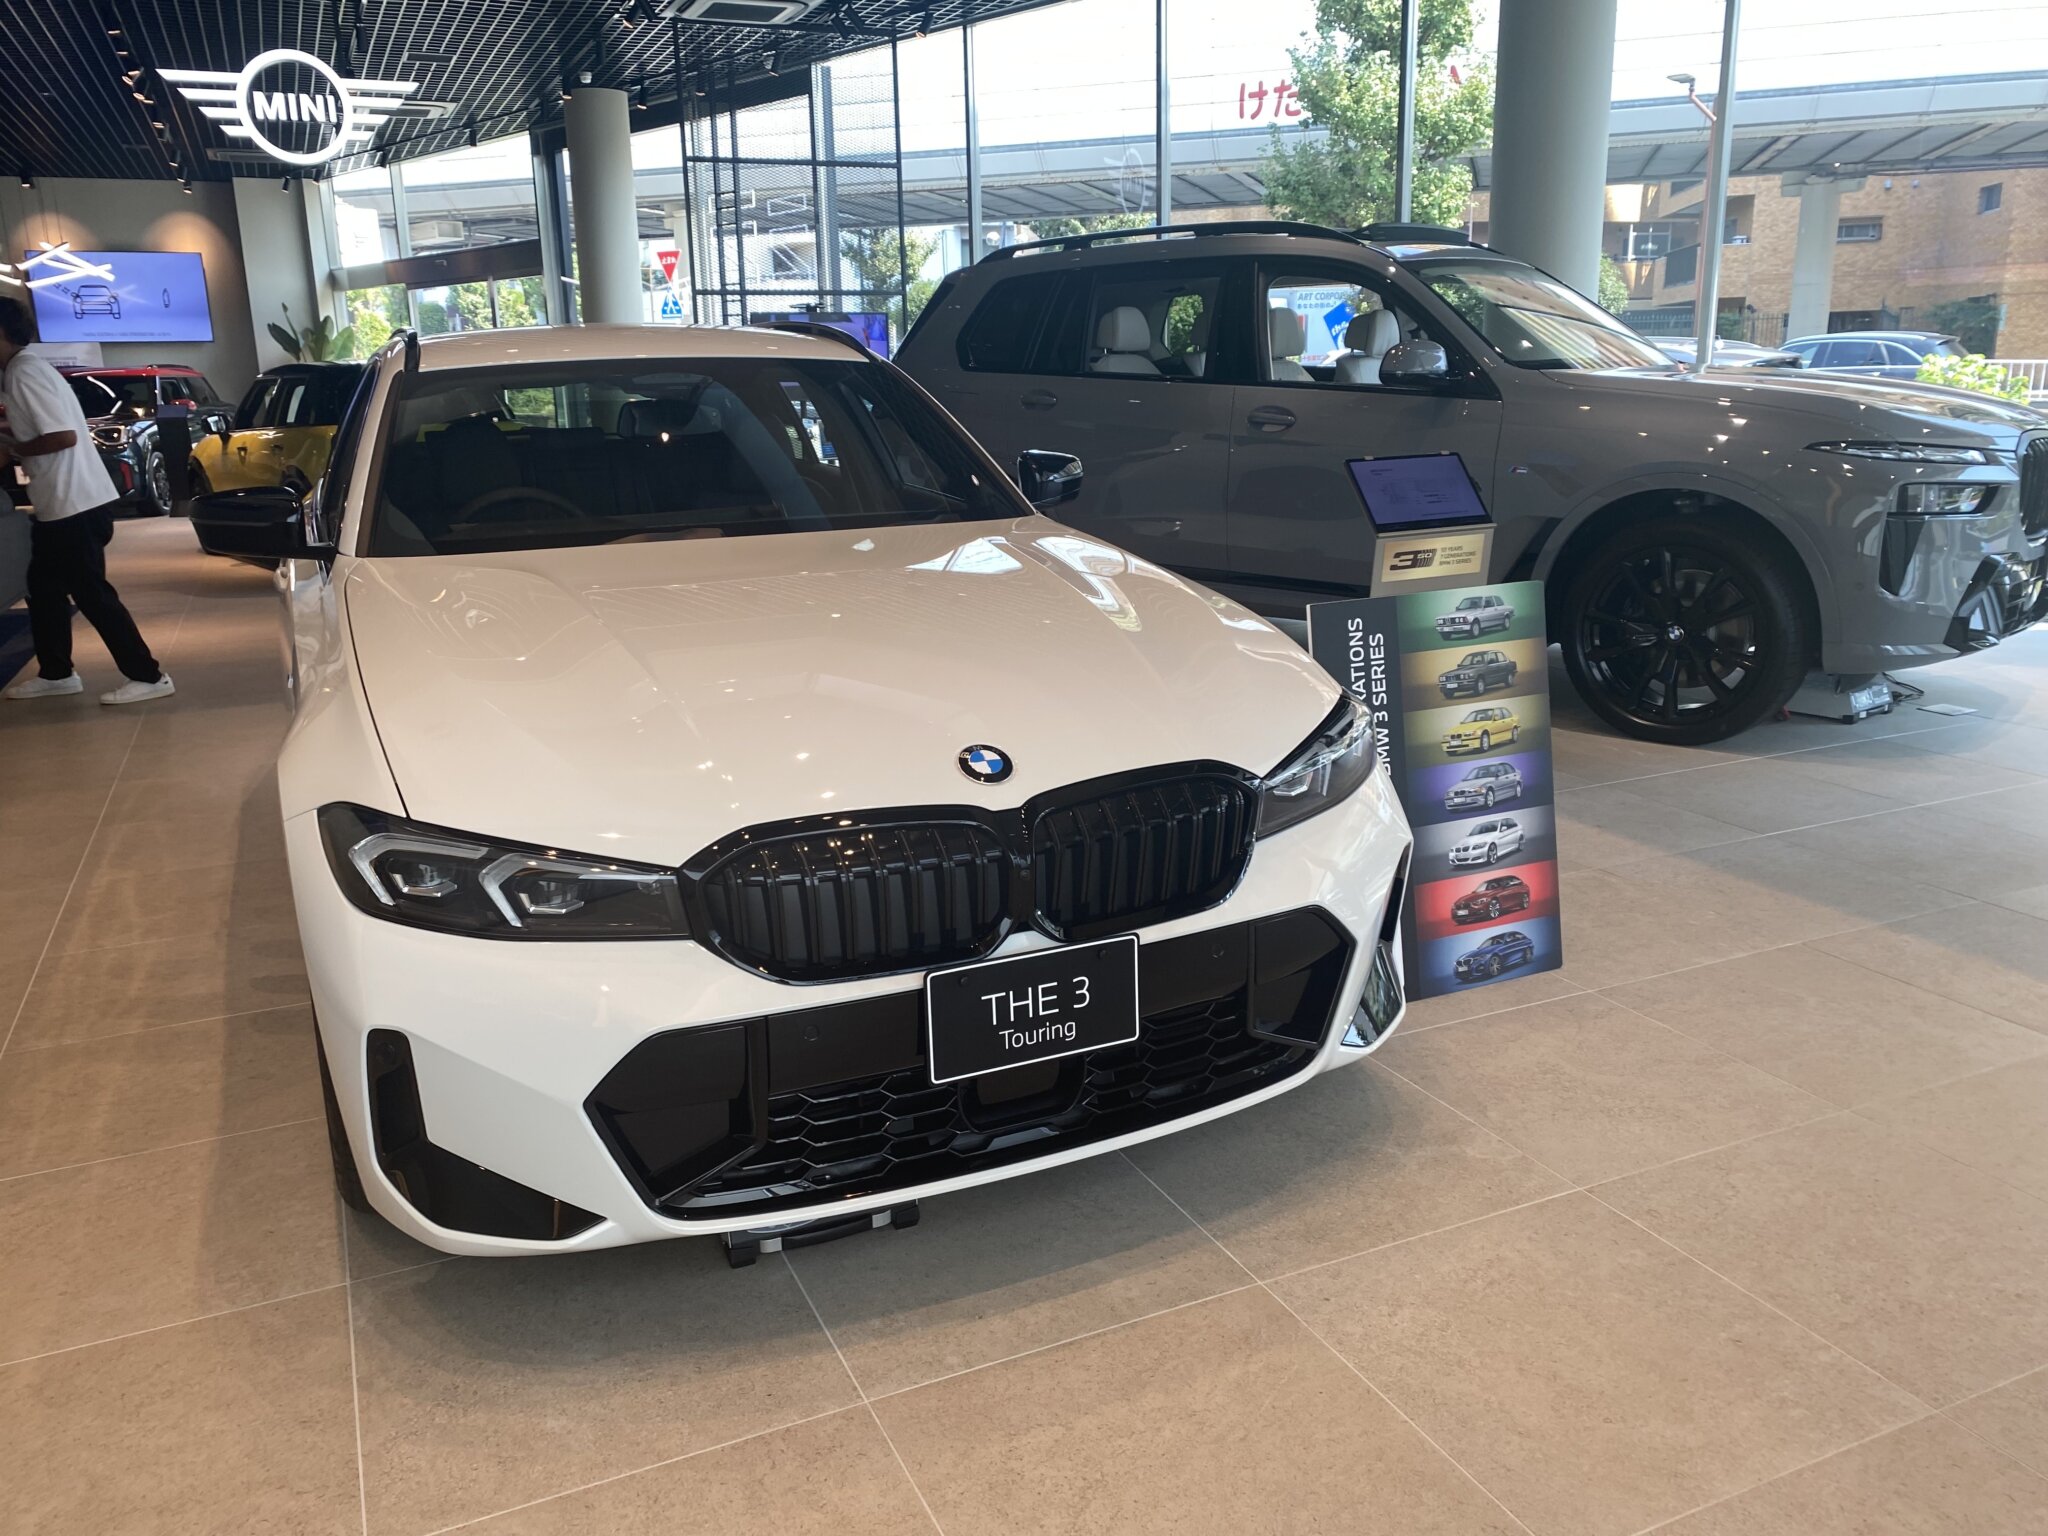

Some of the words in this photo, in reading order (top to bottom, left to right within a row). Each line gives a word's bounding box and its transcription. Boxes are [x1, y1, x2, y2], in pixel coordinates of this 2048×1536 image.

[252, 90, 338, 123] MINI
[1297, 292, 1313, 301] ART
[1443, 551, 1476, 559] GENERATIONS
[1455, 557, 1472, 565] SERIES
[1348, 617, 1367, 701] ATIONS
[1369, 633, 1388, 705] SERIES
[1374, 711, 1389, 722] 3
[981, 980, 1060, 1026] THE
[1072, 975, 1091, 1009] 3
[999, 1018, 1077, 1050] Touring
